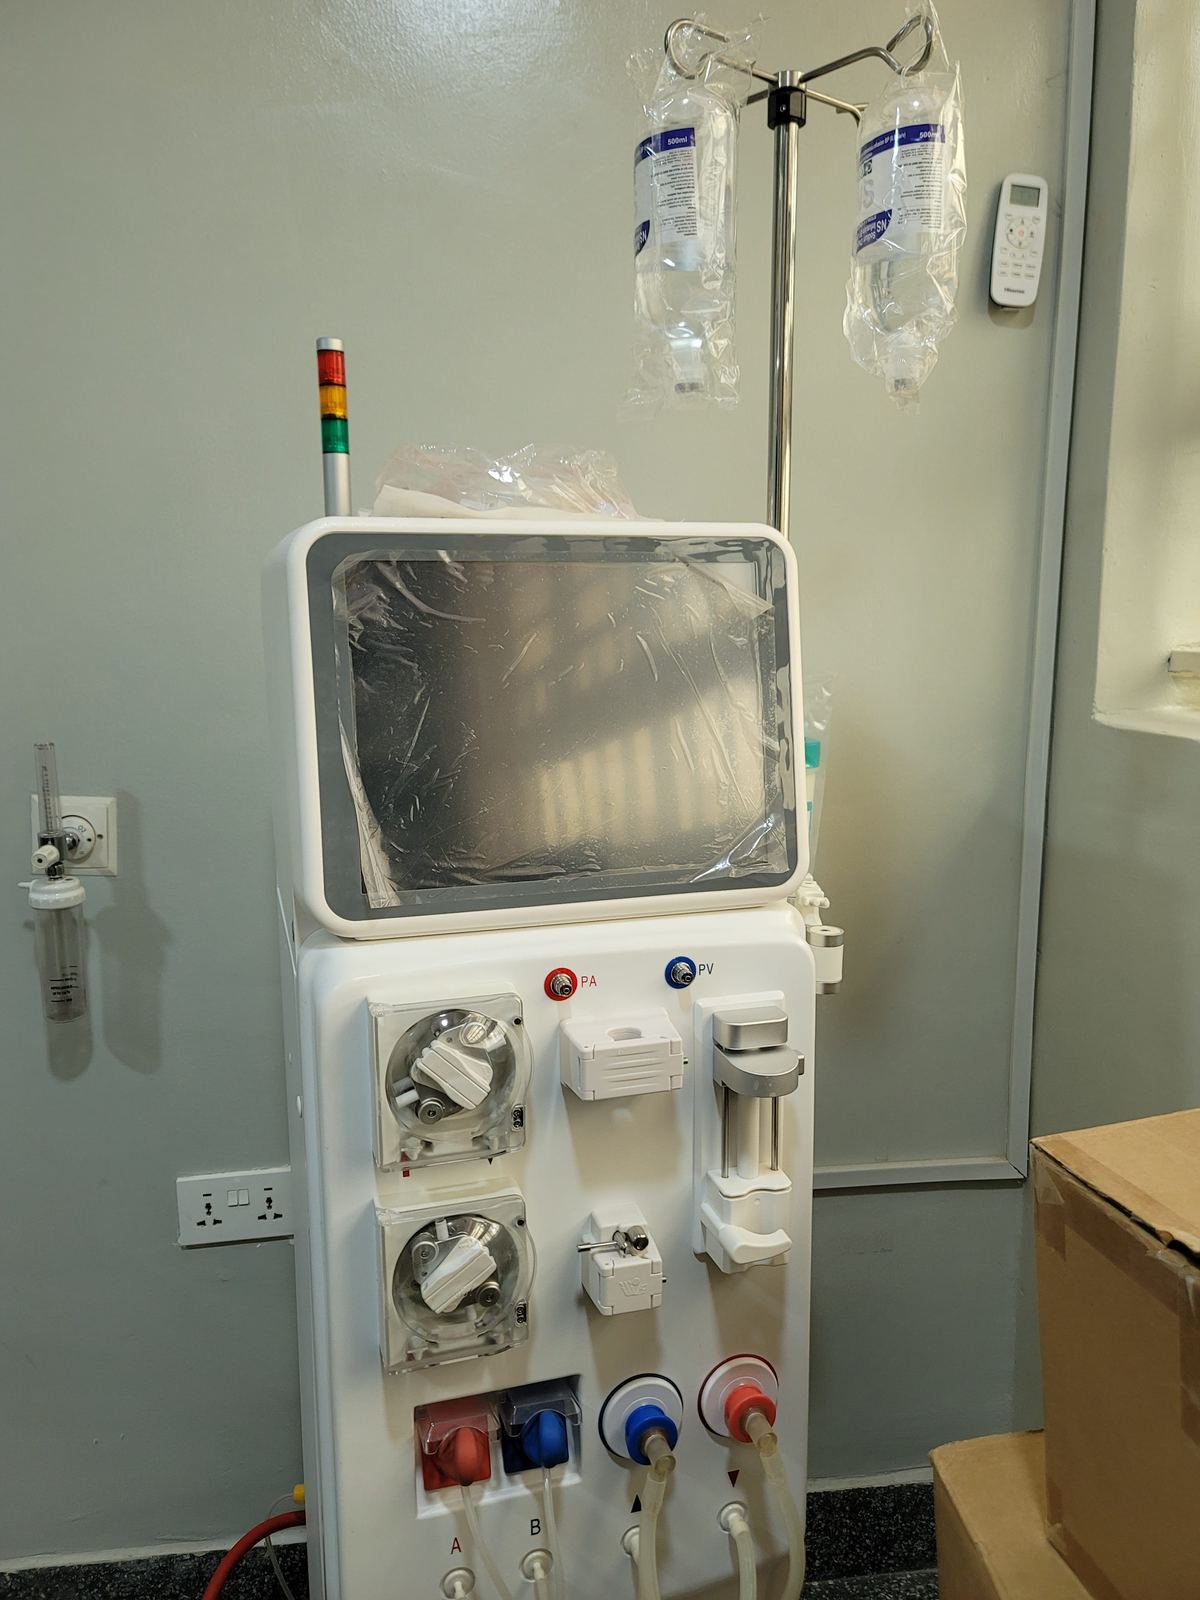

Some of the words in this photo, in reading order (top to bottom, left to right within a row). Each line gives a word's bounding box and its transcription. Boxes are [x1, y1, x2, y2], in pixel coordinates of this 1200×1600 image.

[667, 136, 688, 146] 500ml
[698, 963, 715, 976] PV
[581, 975, 597, 988] PA
[530, 1518, 541, 1536] B
[450, 1536, 462, 1555] A
